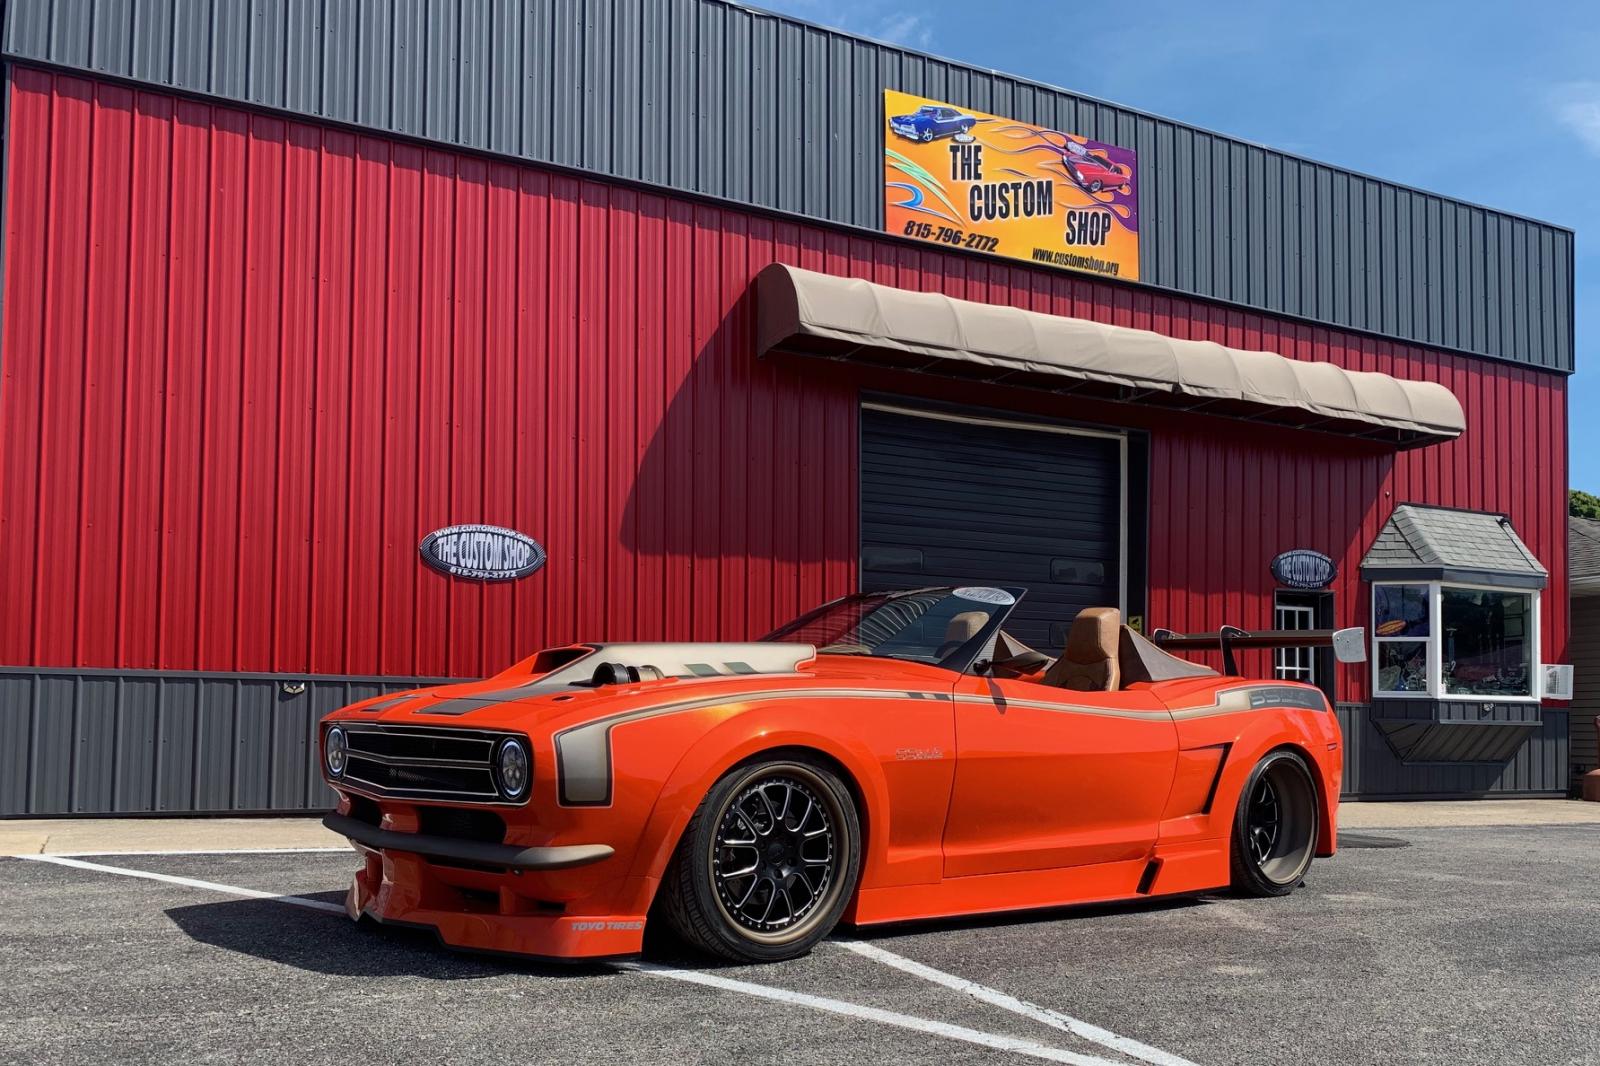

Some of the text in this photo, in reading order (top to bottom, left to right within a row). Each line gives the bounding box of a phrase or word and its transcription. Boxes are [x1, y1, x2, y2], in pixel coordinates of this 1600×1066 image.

[950, 144, 982, 181] THE
[969, 180, 1053, 222] CUSTOM
[903, 220, 1000, 252] 815-796-2772
[1065, 210, 1112, 246] SHOP
[1032, 247, 1120, 276] www.customshop.org
[437, 532, 530, 570] THE CUSTOM SHOP
